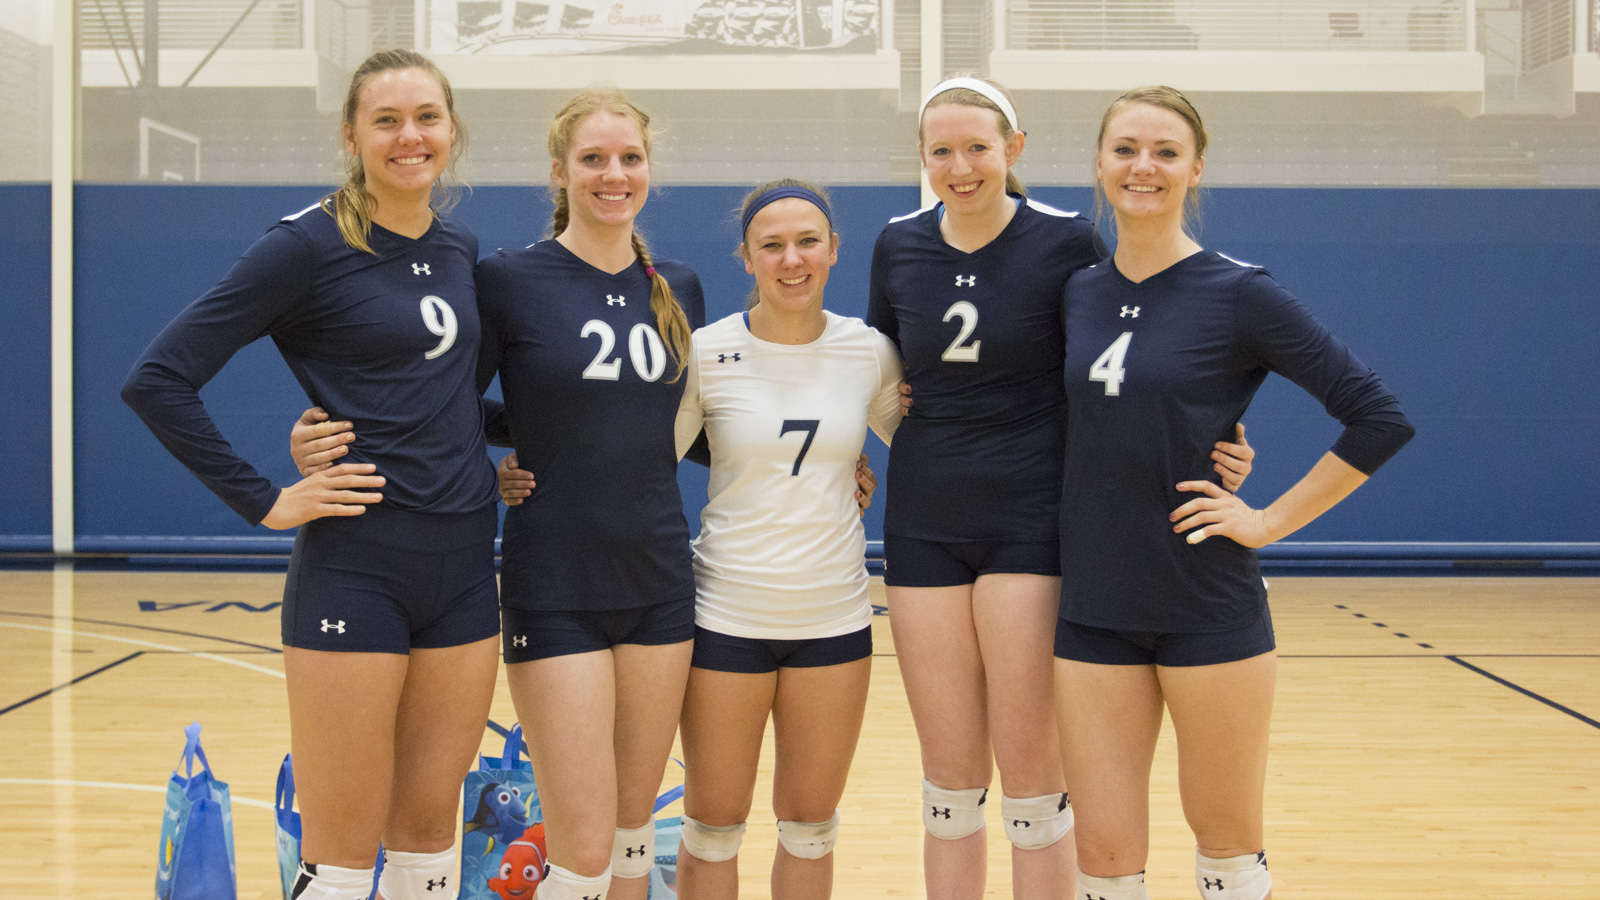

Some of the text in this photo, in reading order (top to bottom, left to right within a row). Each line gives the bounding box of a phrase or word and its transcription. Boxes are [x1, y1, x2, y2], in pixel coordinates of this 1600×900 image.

[420, 295, 458, 360] 9
[580, 319, 667, 382] 20
[941, 300, 981, 363] 2
[1088, 331, 1133, 396] 4
[778, 418, 823, 478] 7
